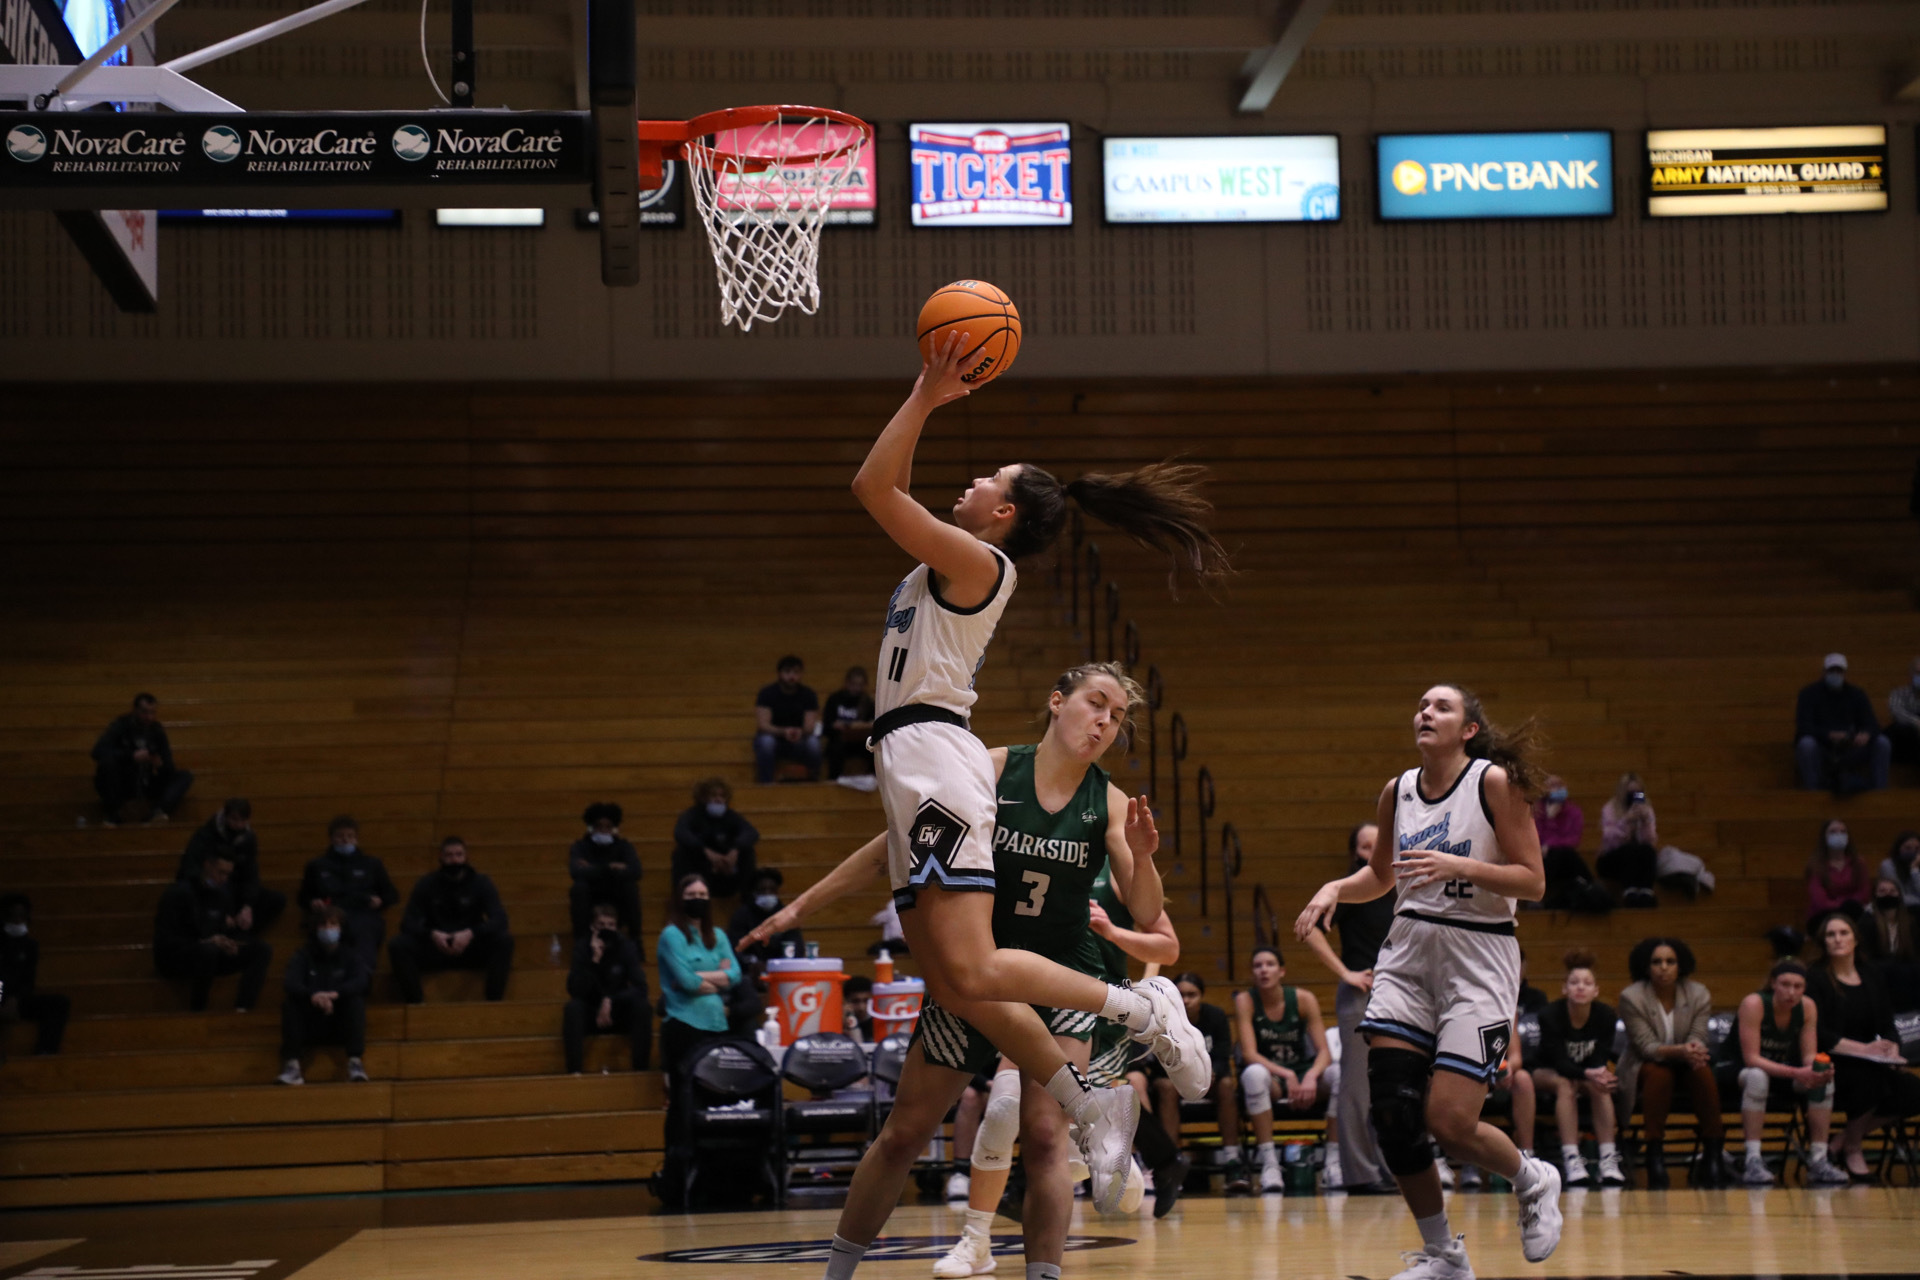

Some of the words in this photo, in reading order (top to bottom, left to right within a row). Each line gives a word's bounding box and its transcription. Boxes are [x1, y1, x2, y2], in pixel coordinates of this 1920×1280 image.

[0, 0, 59, 65] AKER
[51, 129, 186, 155] NovaCare
[245, 129, 377, 155] NovaCare
[433, 128, 563, 154] NovaCare
[52, 161, 182, 173] REHABILITATION
[247, 160, 372, 172] REHABILITATION
[435, 158, 559, 171] REHABILITATION
[911, 148, 1071, 203] TICKET
[1652, 167, 1705, 185] ARMY
[1707, 164, 1799, 184] NATIONAL
[1800, 162, 1866, 181] GUARD
[1111, 173, 1213, 194] CAMPUS
[1217, 165, 1285, 197] WEST
[888, 646, 908, 682] 11
[917, 824, 946, 848] GV
[992, 825, 1090, 869] PARKSIDE
[1014, 869, 1051, 917] 3
[792, 986, 817, 1013] G
